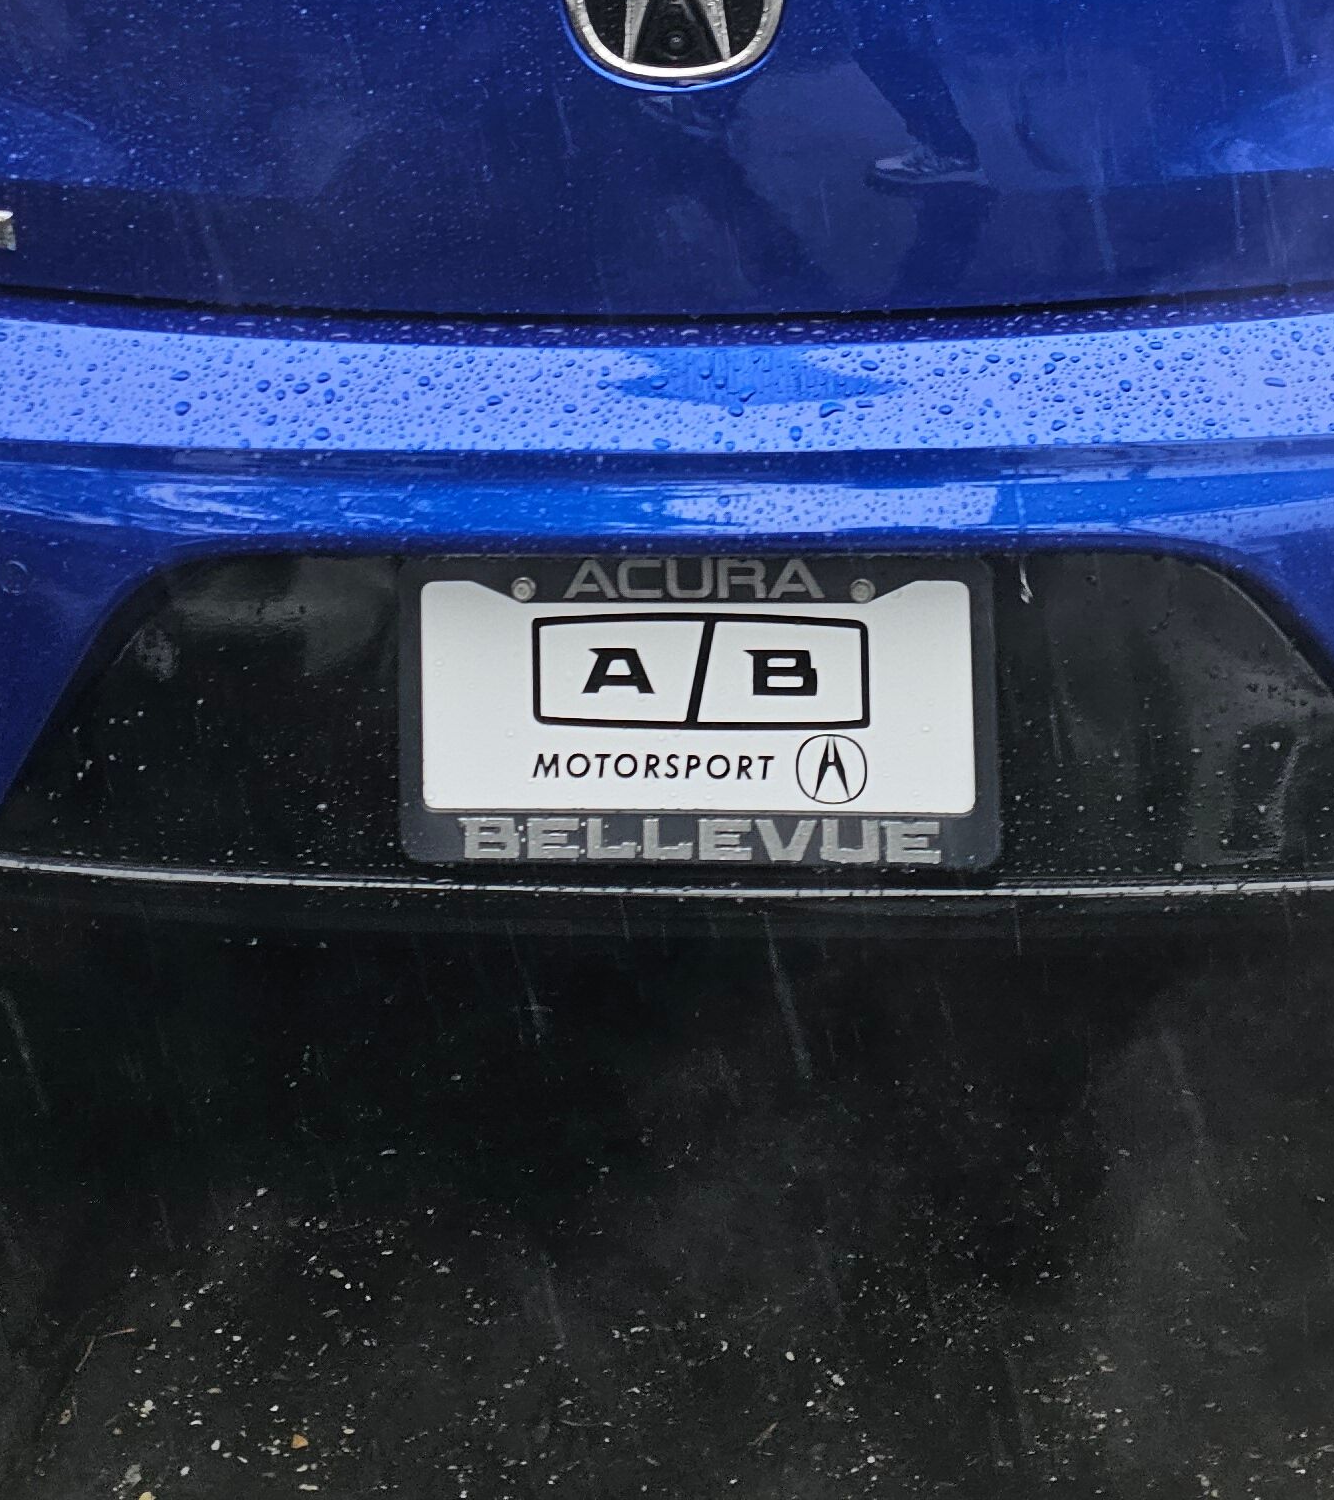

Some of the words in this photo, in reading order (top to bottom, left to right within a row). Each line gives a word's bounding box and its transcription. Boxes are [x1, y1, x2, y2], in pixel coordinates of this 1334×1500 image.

[563, 558, 826, 601] ACURA
[581, 647, 655, 695] A
[744, 648, 818, 697] B
[531, 752, 775, 782] MOTORSPORT
[457, 816, 942, 865] BELLEVUE
